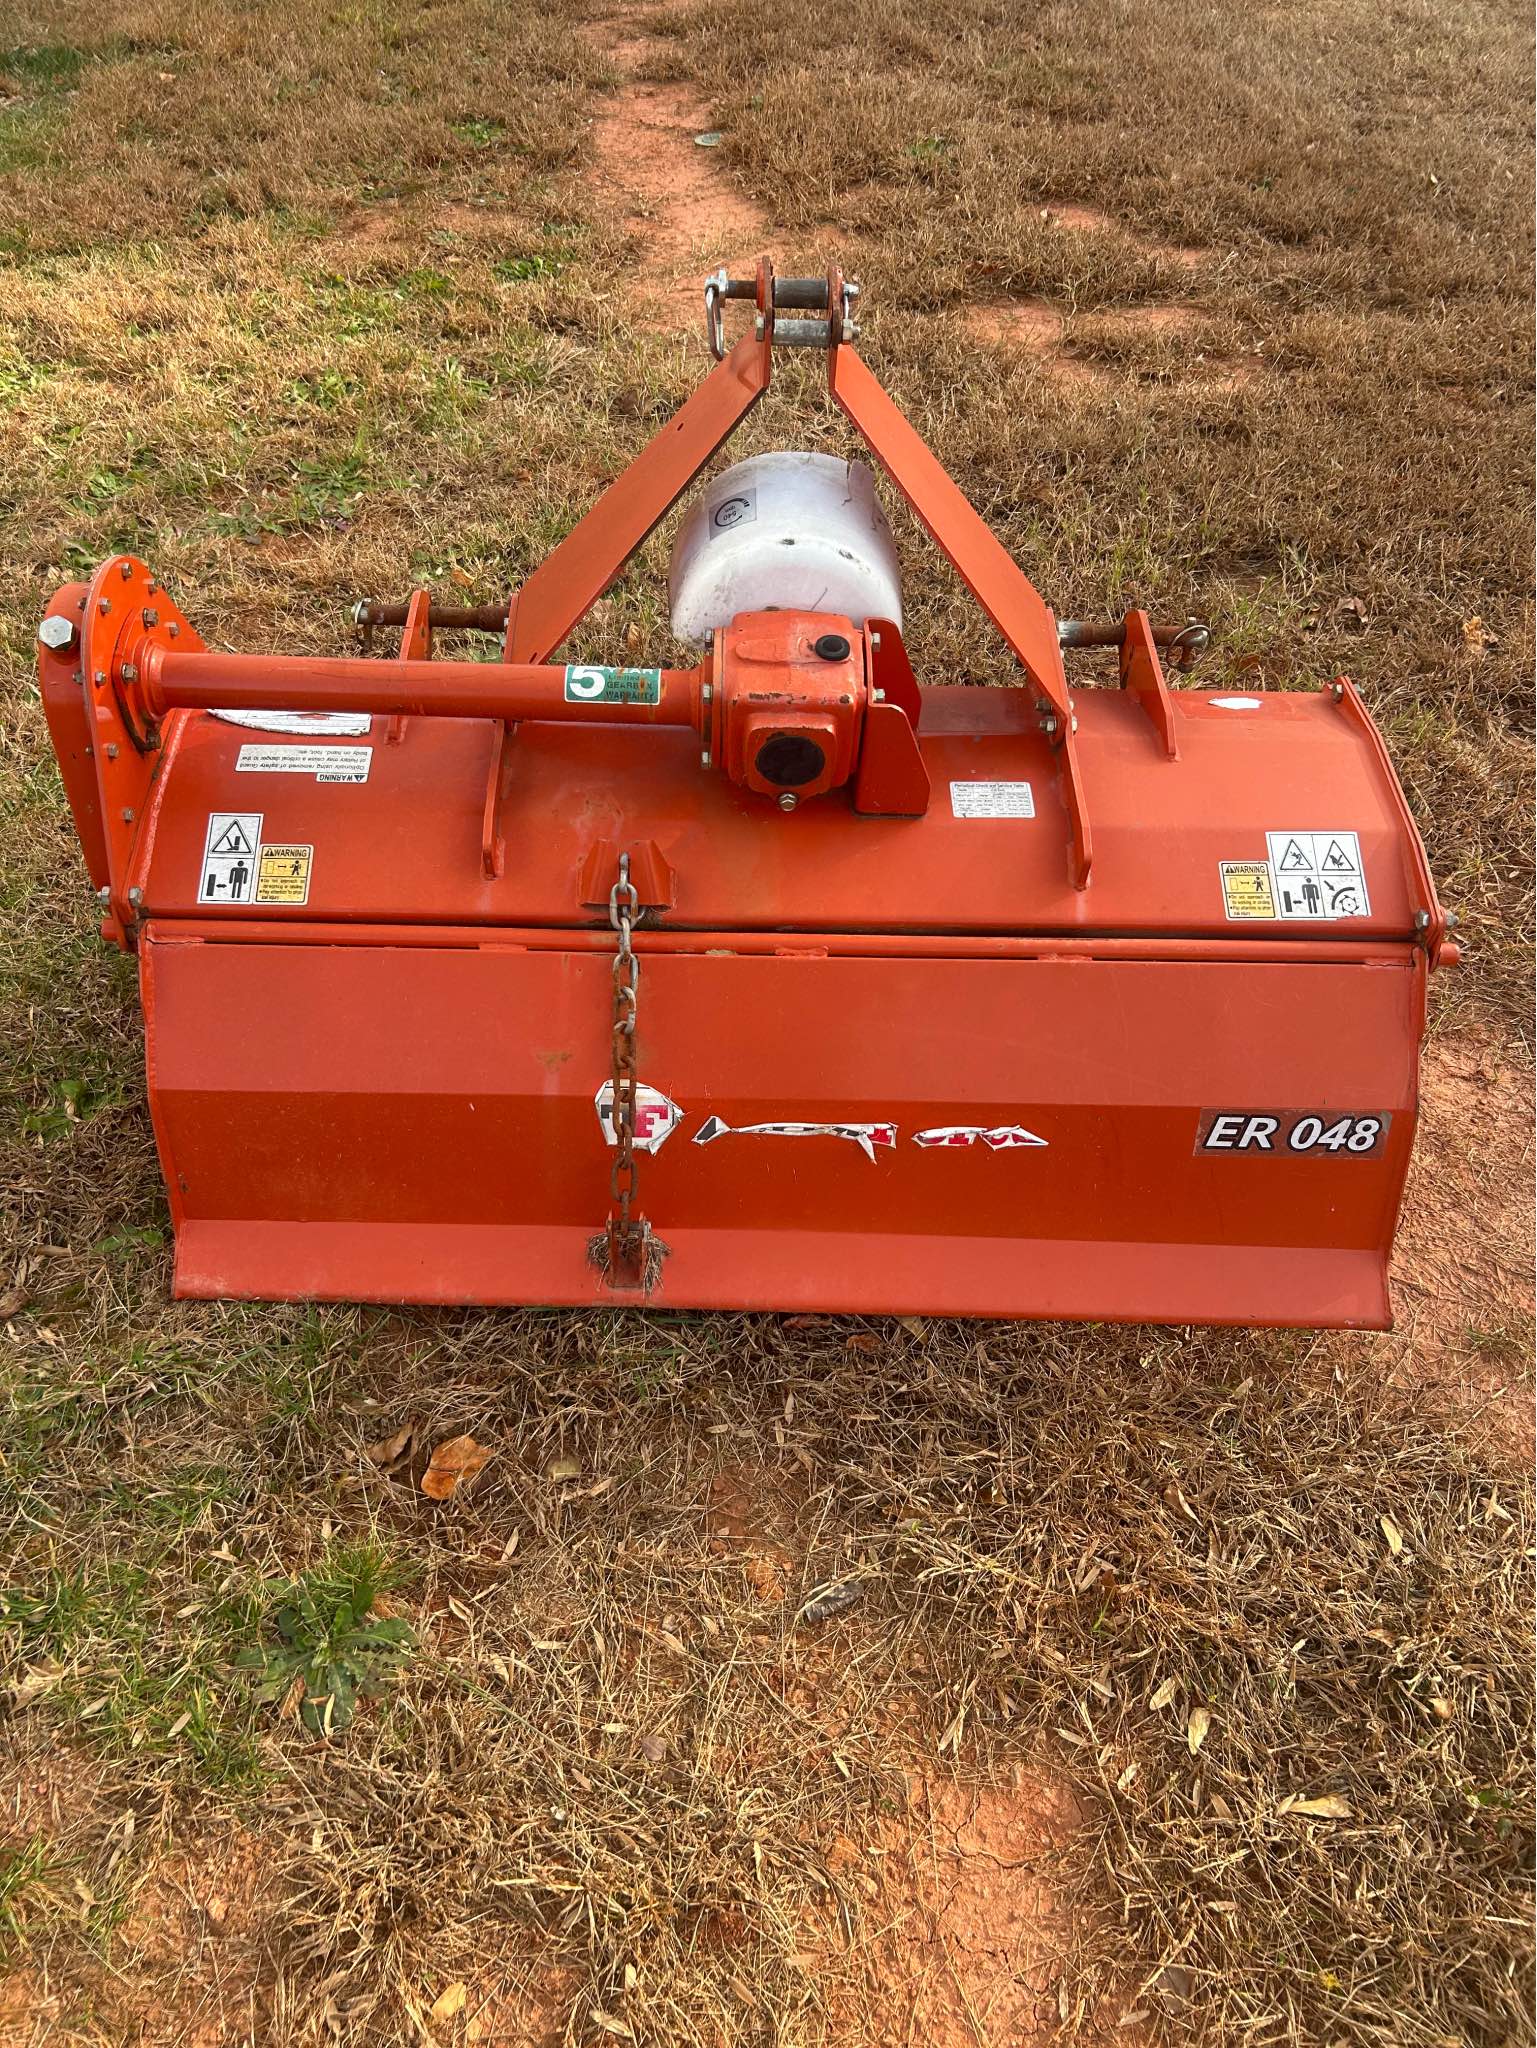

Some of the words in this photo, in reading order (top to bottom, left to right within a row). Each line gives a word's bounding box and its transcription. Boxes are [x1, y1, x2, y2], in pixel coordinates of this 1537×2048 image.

[569, 666, 606, 698] 5
[607, 681, 653, 690] GEARBX
[274, 848, 307, 857] WARNING
[1232, 865, 1266, 874] WARNING
[1203, 1114, 1280, 1150] ER
[1288, 1115, 1382, 1153] 048
